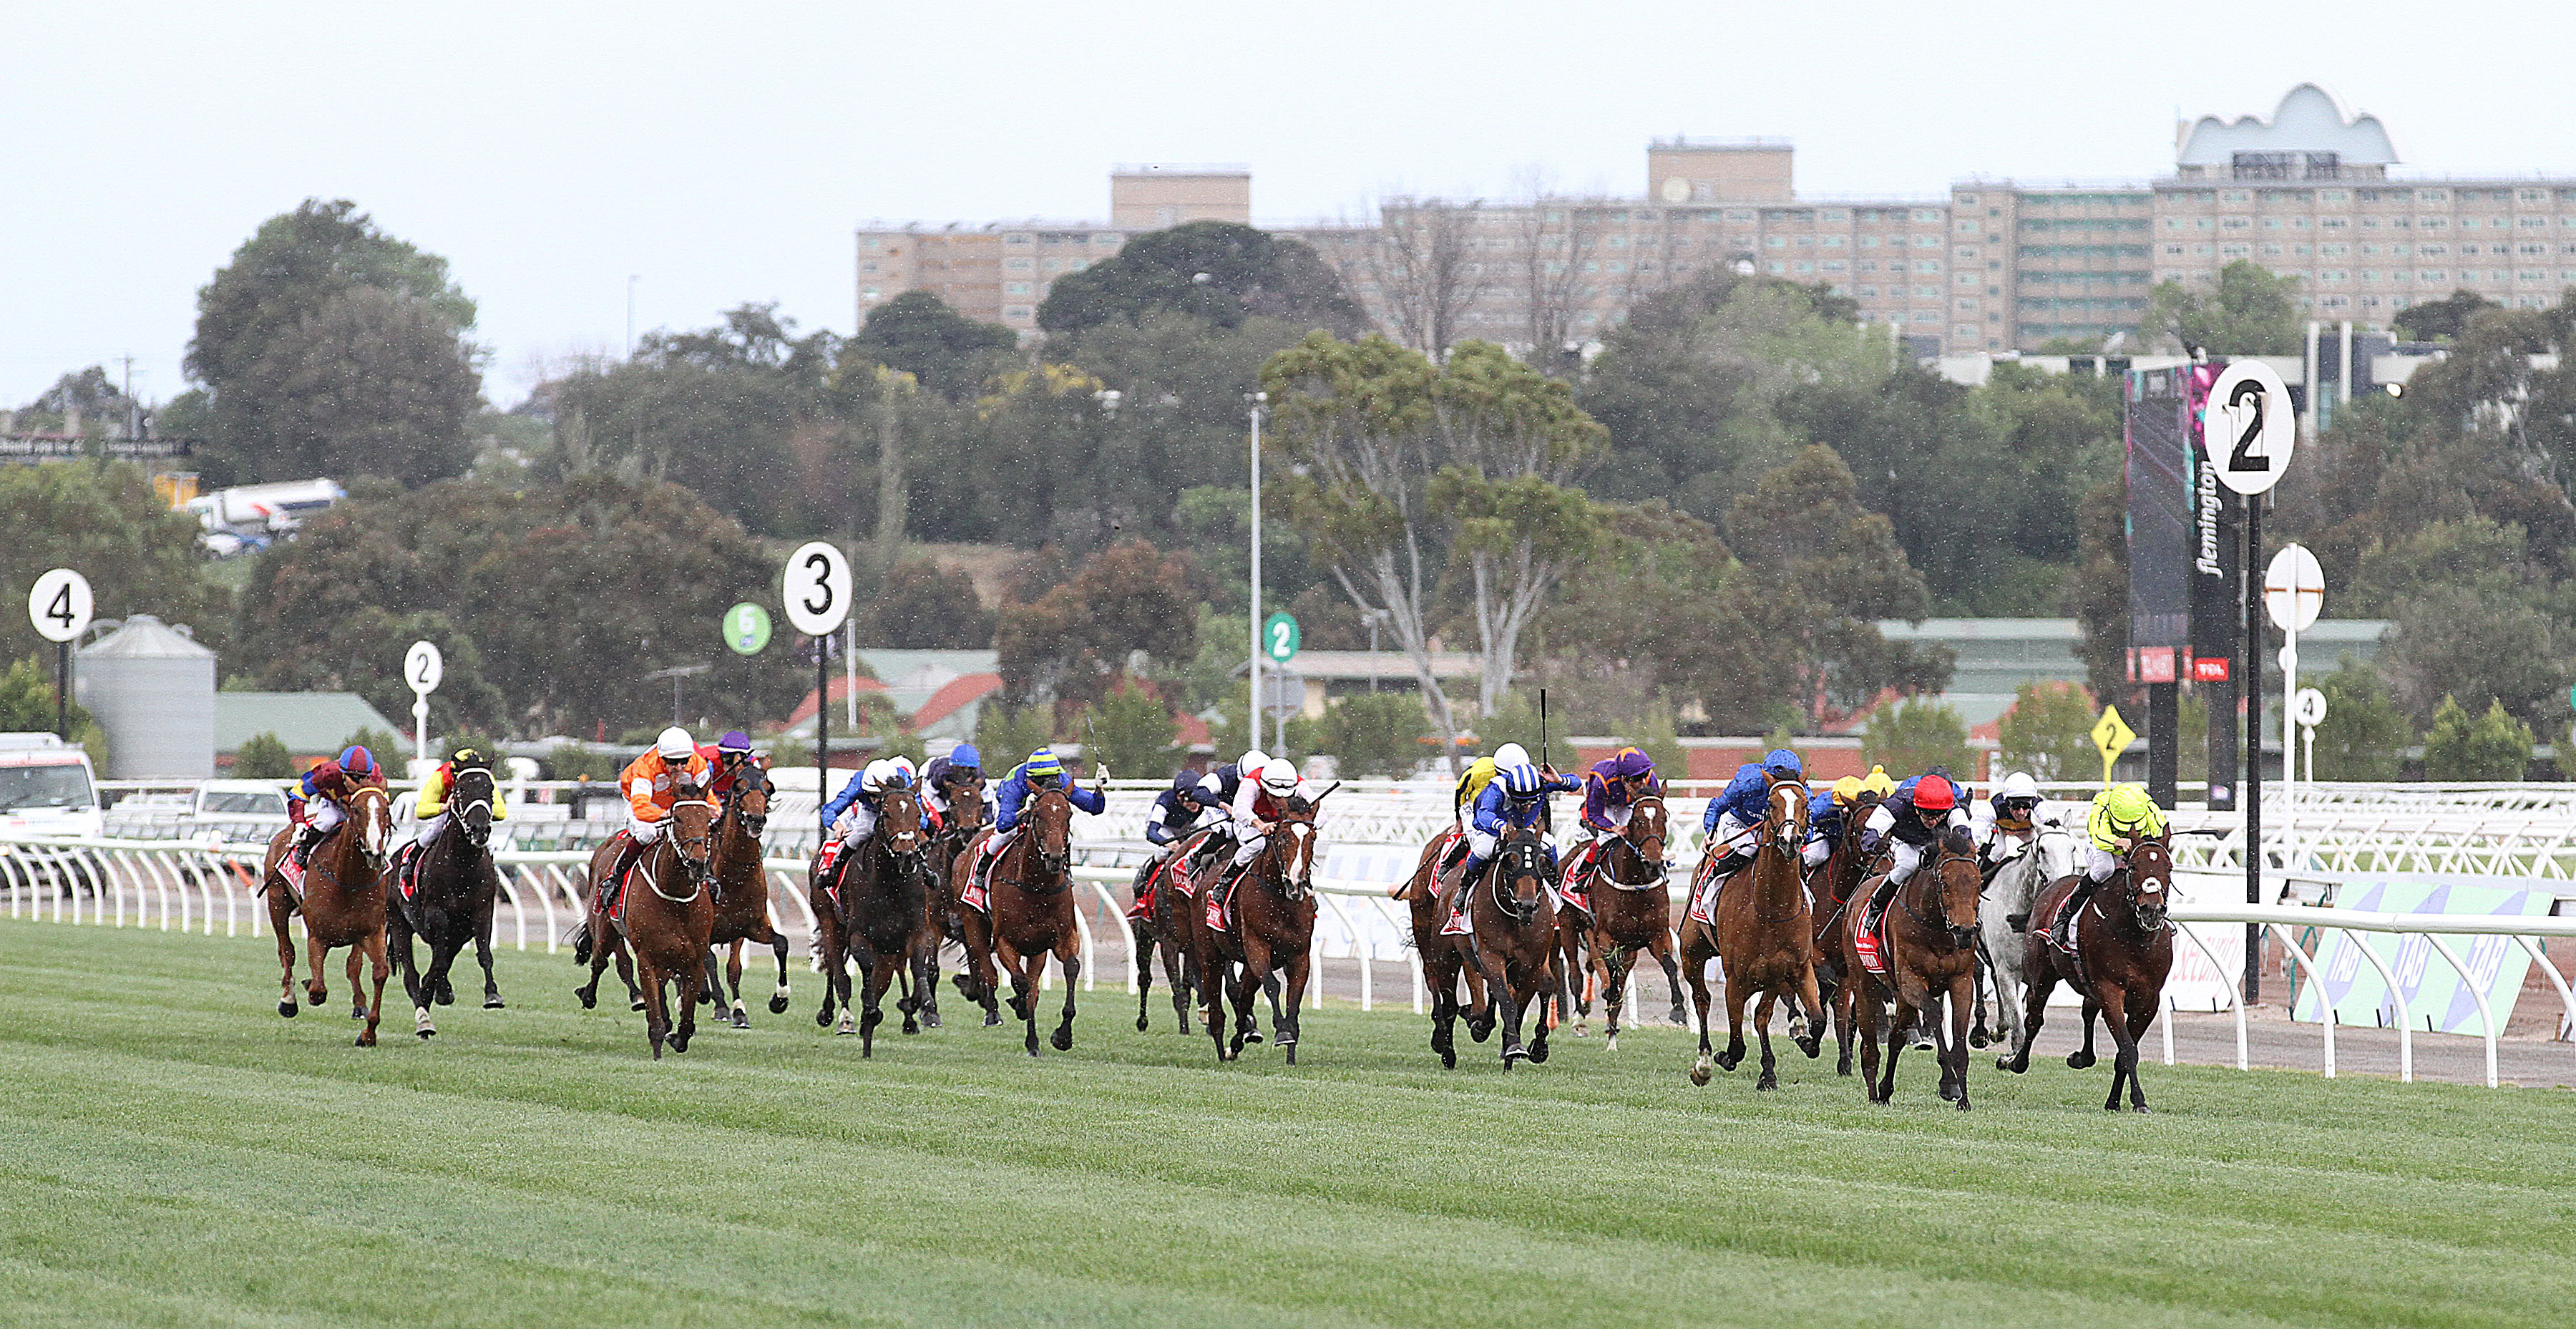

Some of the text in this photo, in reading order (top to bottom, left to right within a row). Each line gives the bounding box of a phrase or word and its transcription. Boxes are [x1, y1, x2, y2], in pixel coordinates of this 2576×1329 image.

[2228, 379, 2270, 472] 2
[2195, 460, 2223, 579] flemington
[47, 582, 75, 628] 4
[804, 553, 833, 615] 3
[1273, 621, 1291, 658] 2
[416, 652, 429, 683] 2
[2106, 722, 2117, 751] 2
[2399, 933, 2433, 988] TAB
